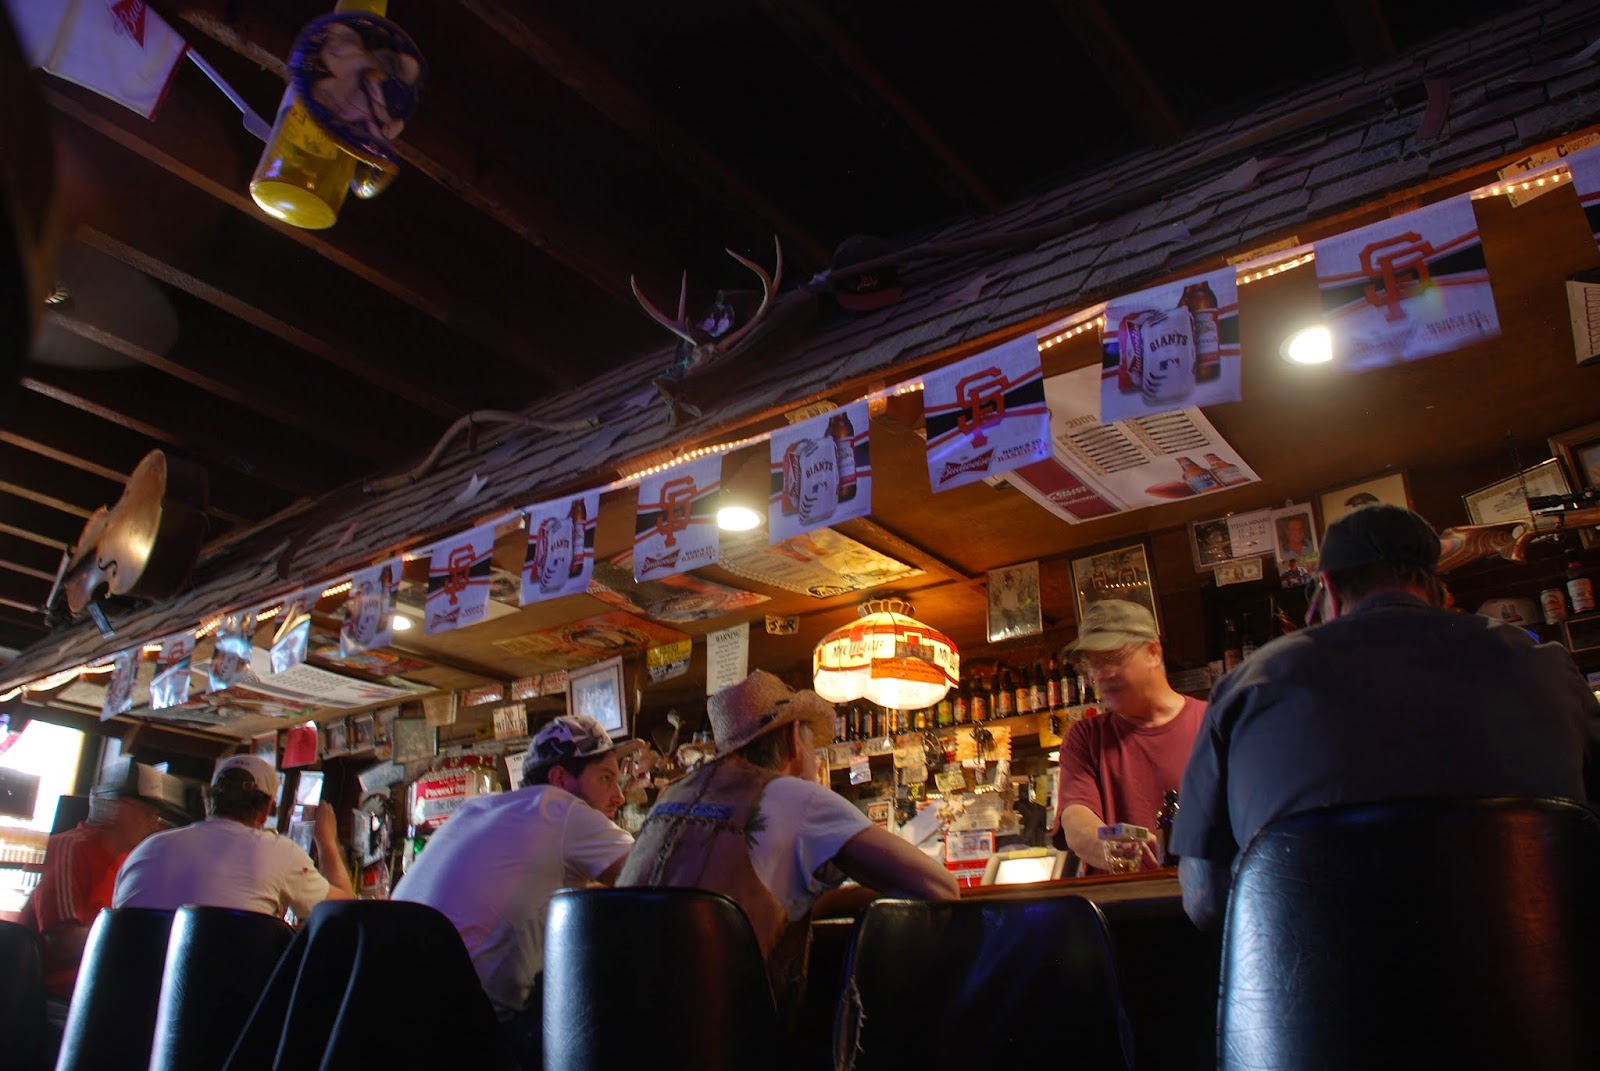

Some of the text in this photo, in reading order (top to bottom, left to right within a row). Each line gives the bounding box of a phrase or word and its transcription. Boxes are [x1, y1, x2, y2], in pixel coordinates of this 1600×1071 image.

[1150, 329, 1188, 352] GIANTS
[1064, 413, 1096, 429] 2009
[806, 460, 834, 479] GIANTS
